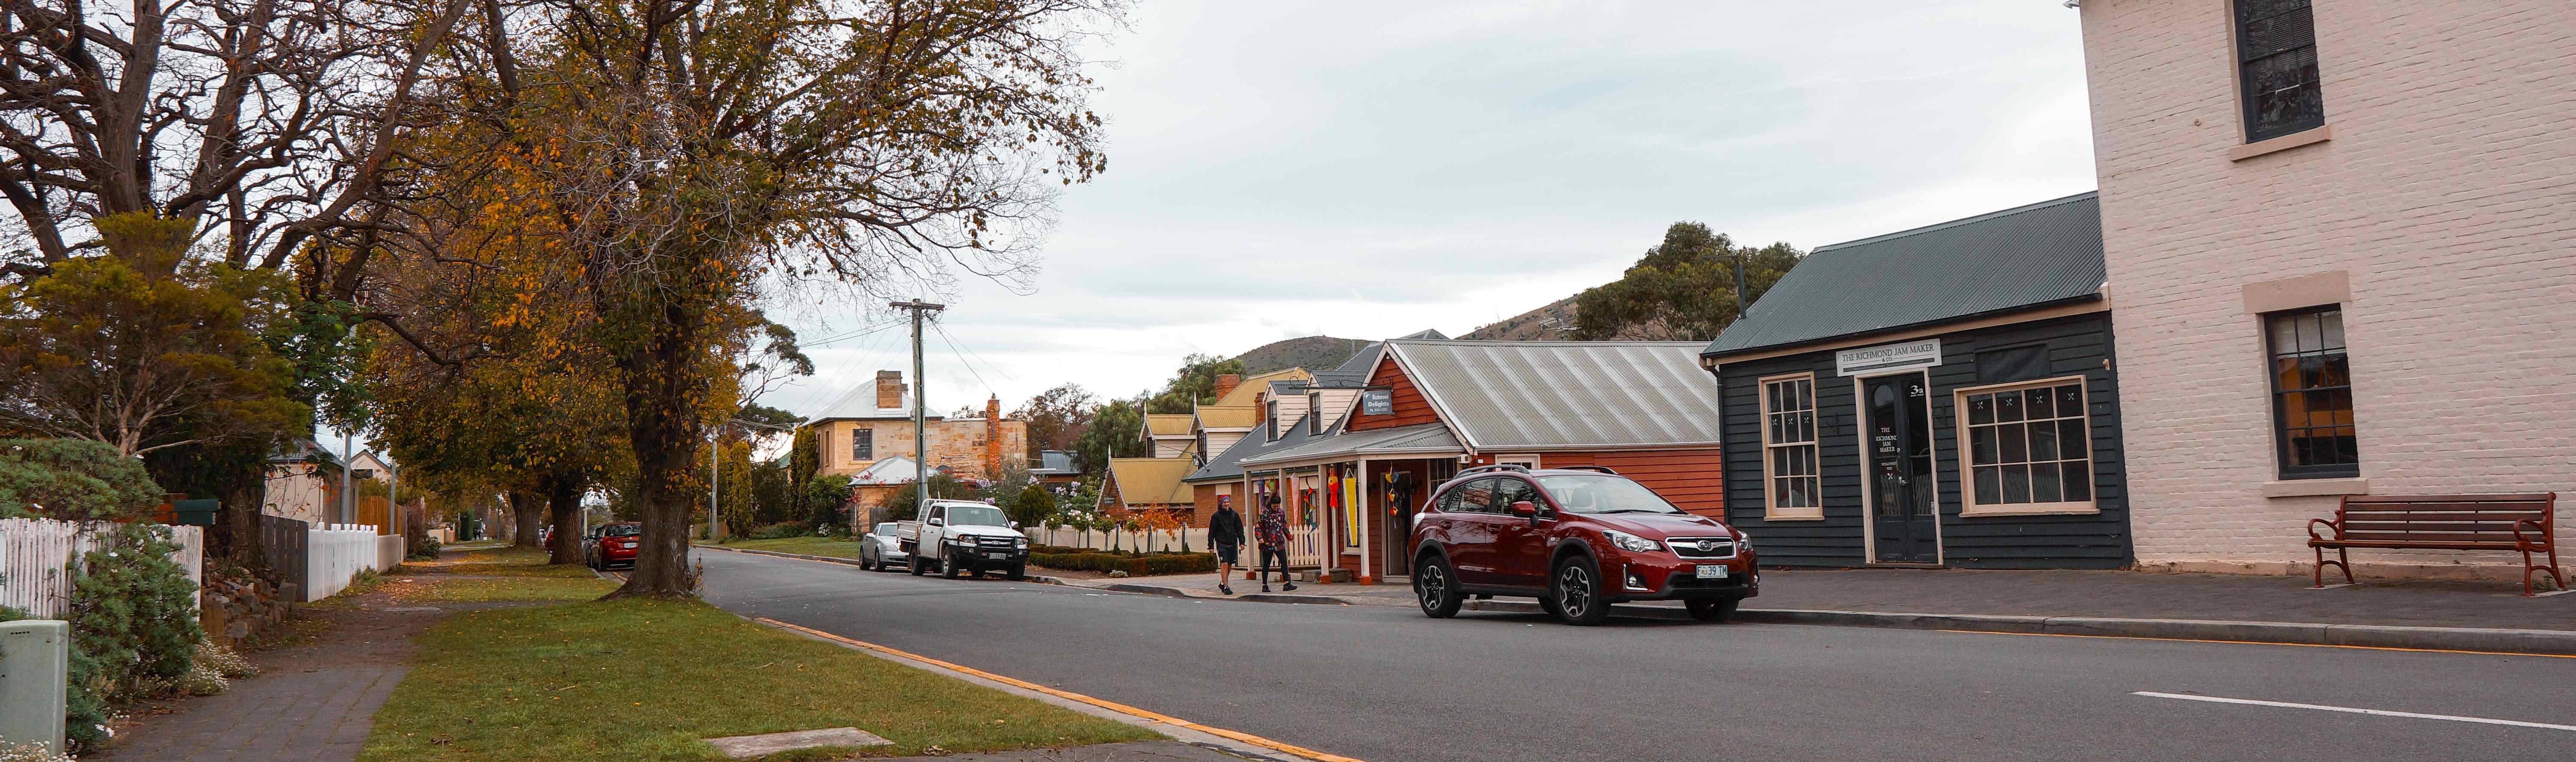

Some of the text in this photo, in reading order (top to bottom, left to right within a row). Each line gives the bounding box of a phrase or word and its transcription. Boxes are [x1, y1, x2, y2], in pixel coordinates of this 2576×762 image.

[1842, 344, 1934, 362] THE RICHMOND JAM MAKER
[1911, 385, 1923, 394] 3a
[1718, 566, 1727, 575] TM
